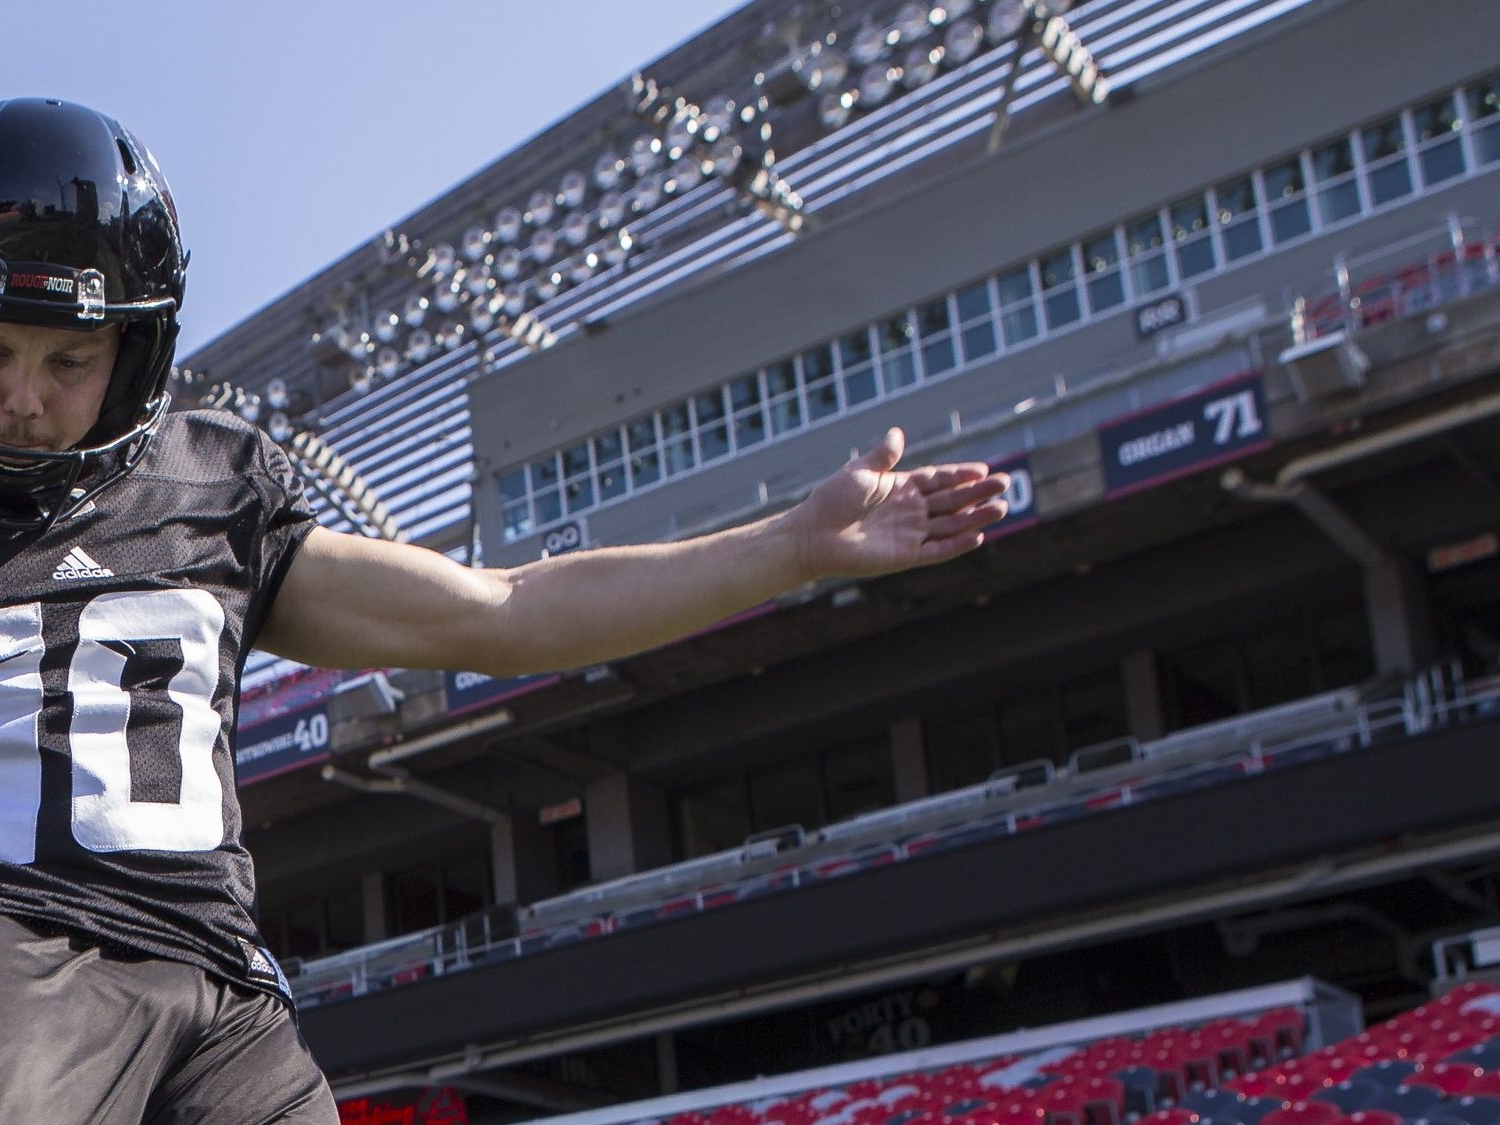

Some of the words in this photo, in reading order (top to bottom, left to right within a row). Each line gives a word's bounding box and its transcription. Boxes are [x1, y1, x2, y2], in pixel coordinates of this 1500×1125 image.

[46, 277, 74, 293] NOIR
[1203, 390, 1263, 445] 71
[52, 568, 115, 580] adidas
[293, 713, 329, 752] 40
